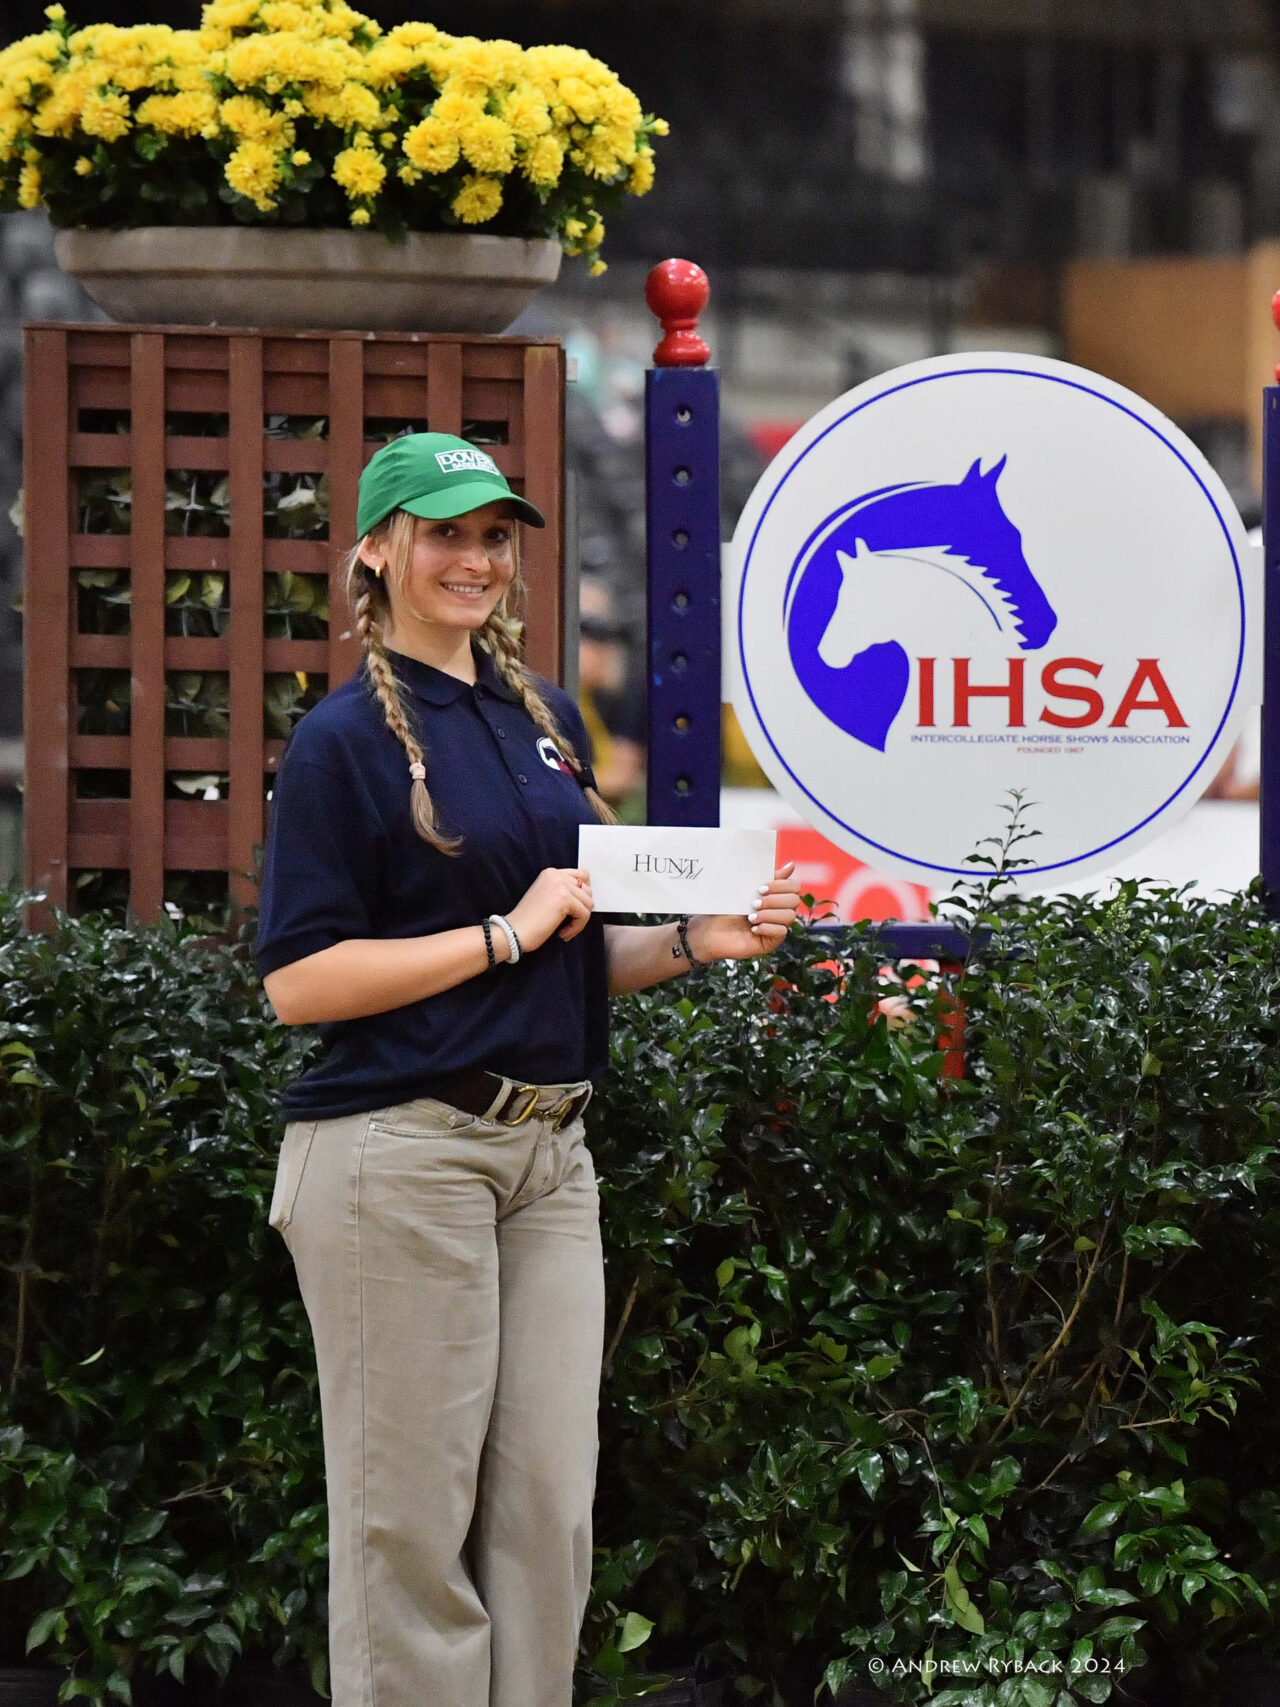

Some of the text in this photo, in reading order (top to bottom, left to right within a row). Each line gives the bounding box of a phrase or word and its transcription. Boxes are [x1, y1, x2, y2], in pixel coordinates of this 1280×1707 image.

[916, 657, 1190, 728] IHSA
[911, 734, 1190, 744] INTERCOLLEGIATE HORSE SHOWS ASSOCIATION
